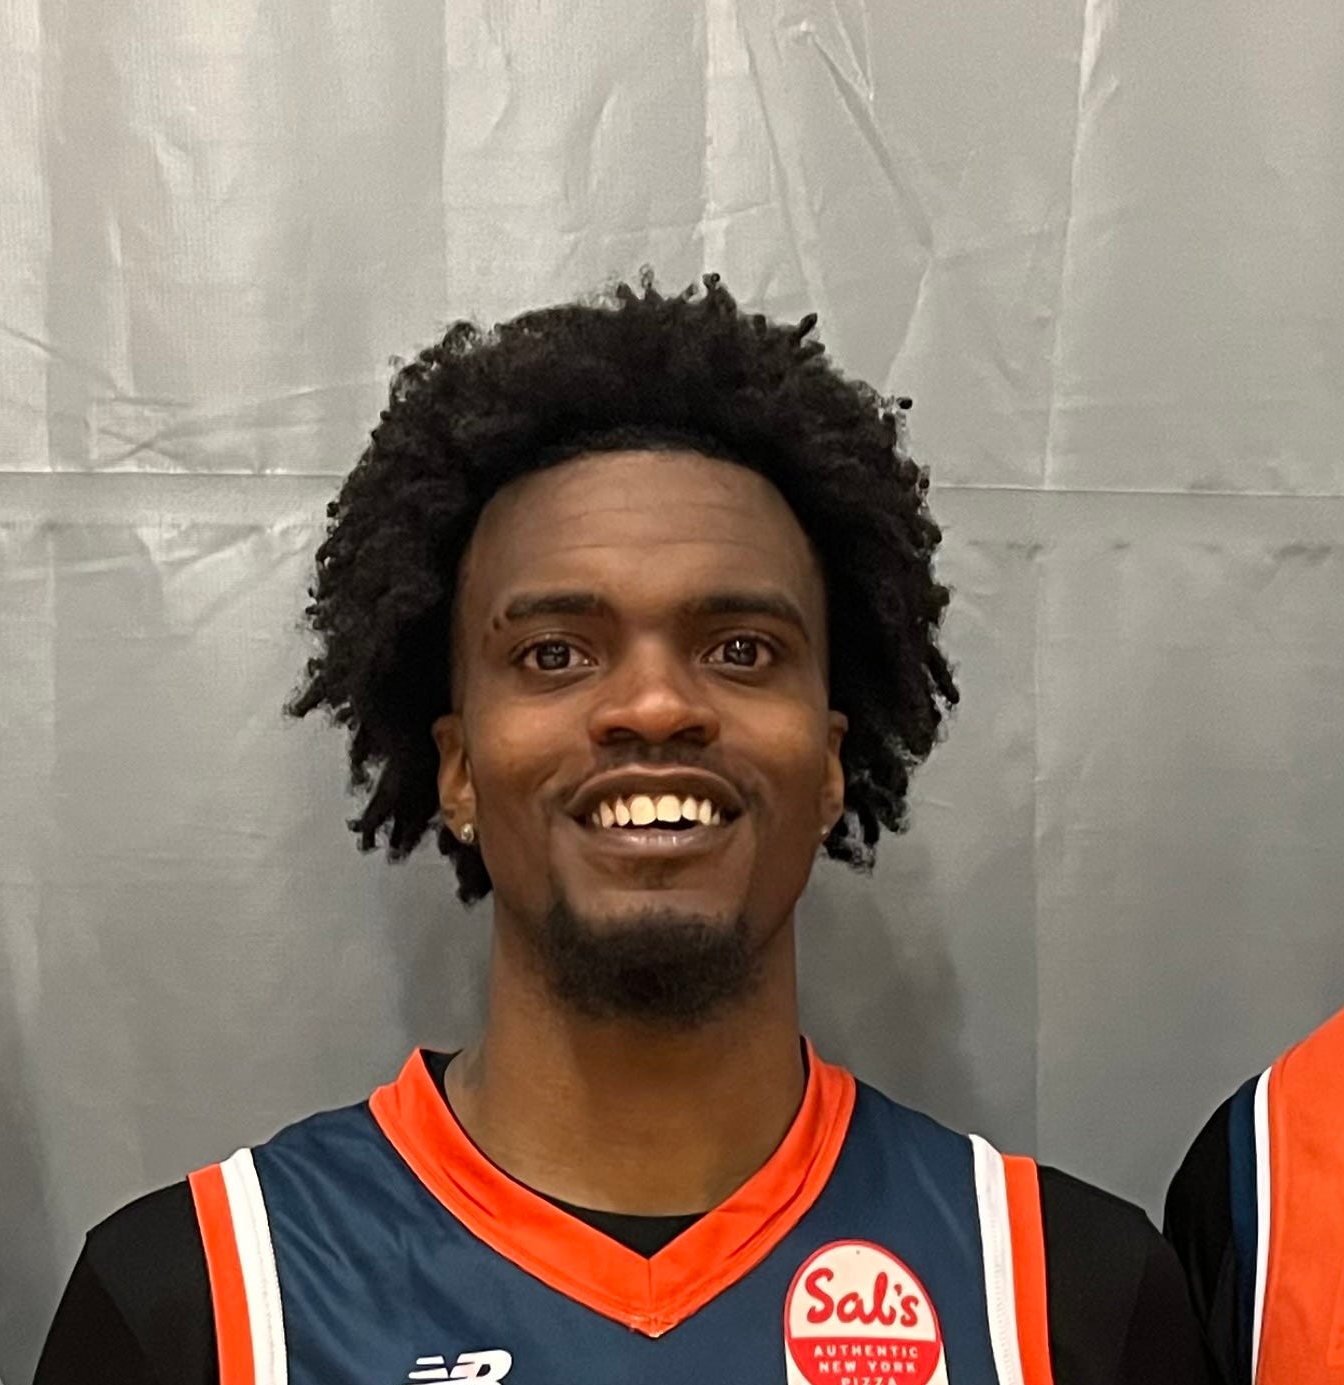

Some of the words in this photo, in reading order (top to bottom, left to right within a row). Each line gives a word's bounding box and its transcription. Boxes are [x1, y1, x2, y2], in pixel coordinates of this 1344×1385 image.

[804, 1267, 919, 1327] Sal's
[814, 1345, 918, 1359] AUTHENTIC
[819, 1361, 856, 1373] NEW
[868, 1361, 916, 1374] YORK
